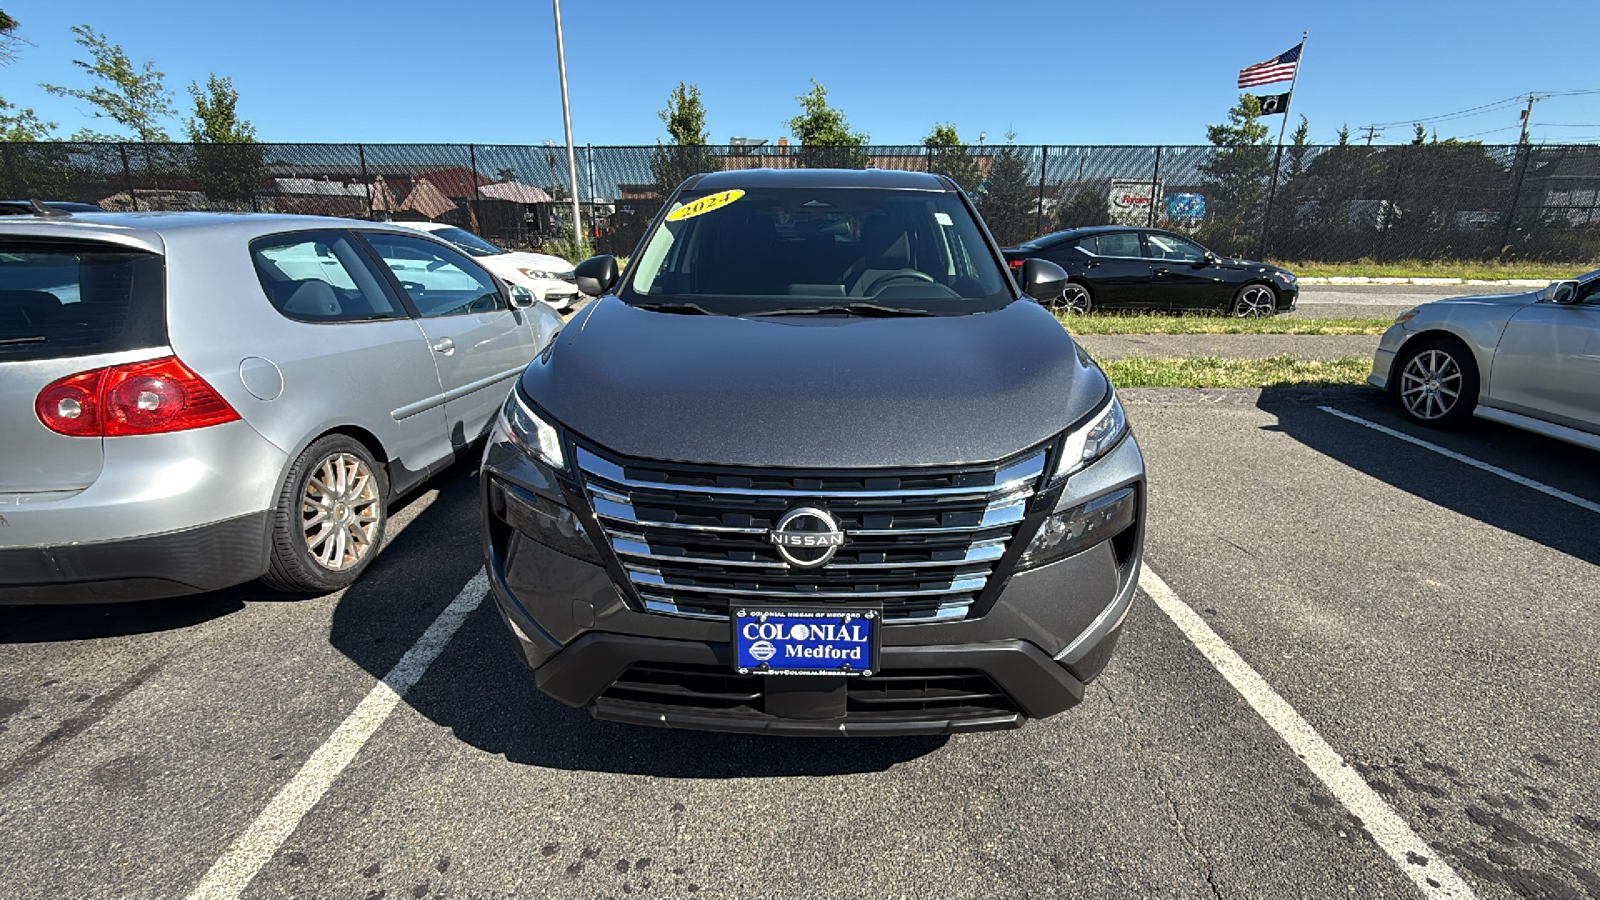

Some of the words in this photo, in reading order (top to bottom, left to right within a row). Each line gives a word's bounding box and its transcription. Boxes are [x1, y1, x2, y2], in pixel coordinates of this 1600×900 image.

[681, 192, 731, 217] 2024
[771, 533, 842, 546] NISSAN
[743, 623, 867, 642] COLONIAL
[785, 644, 861, 659] Medford
